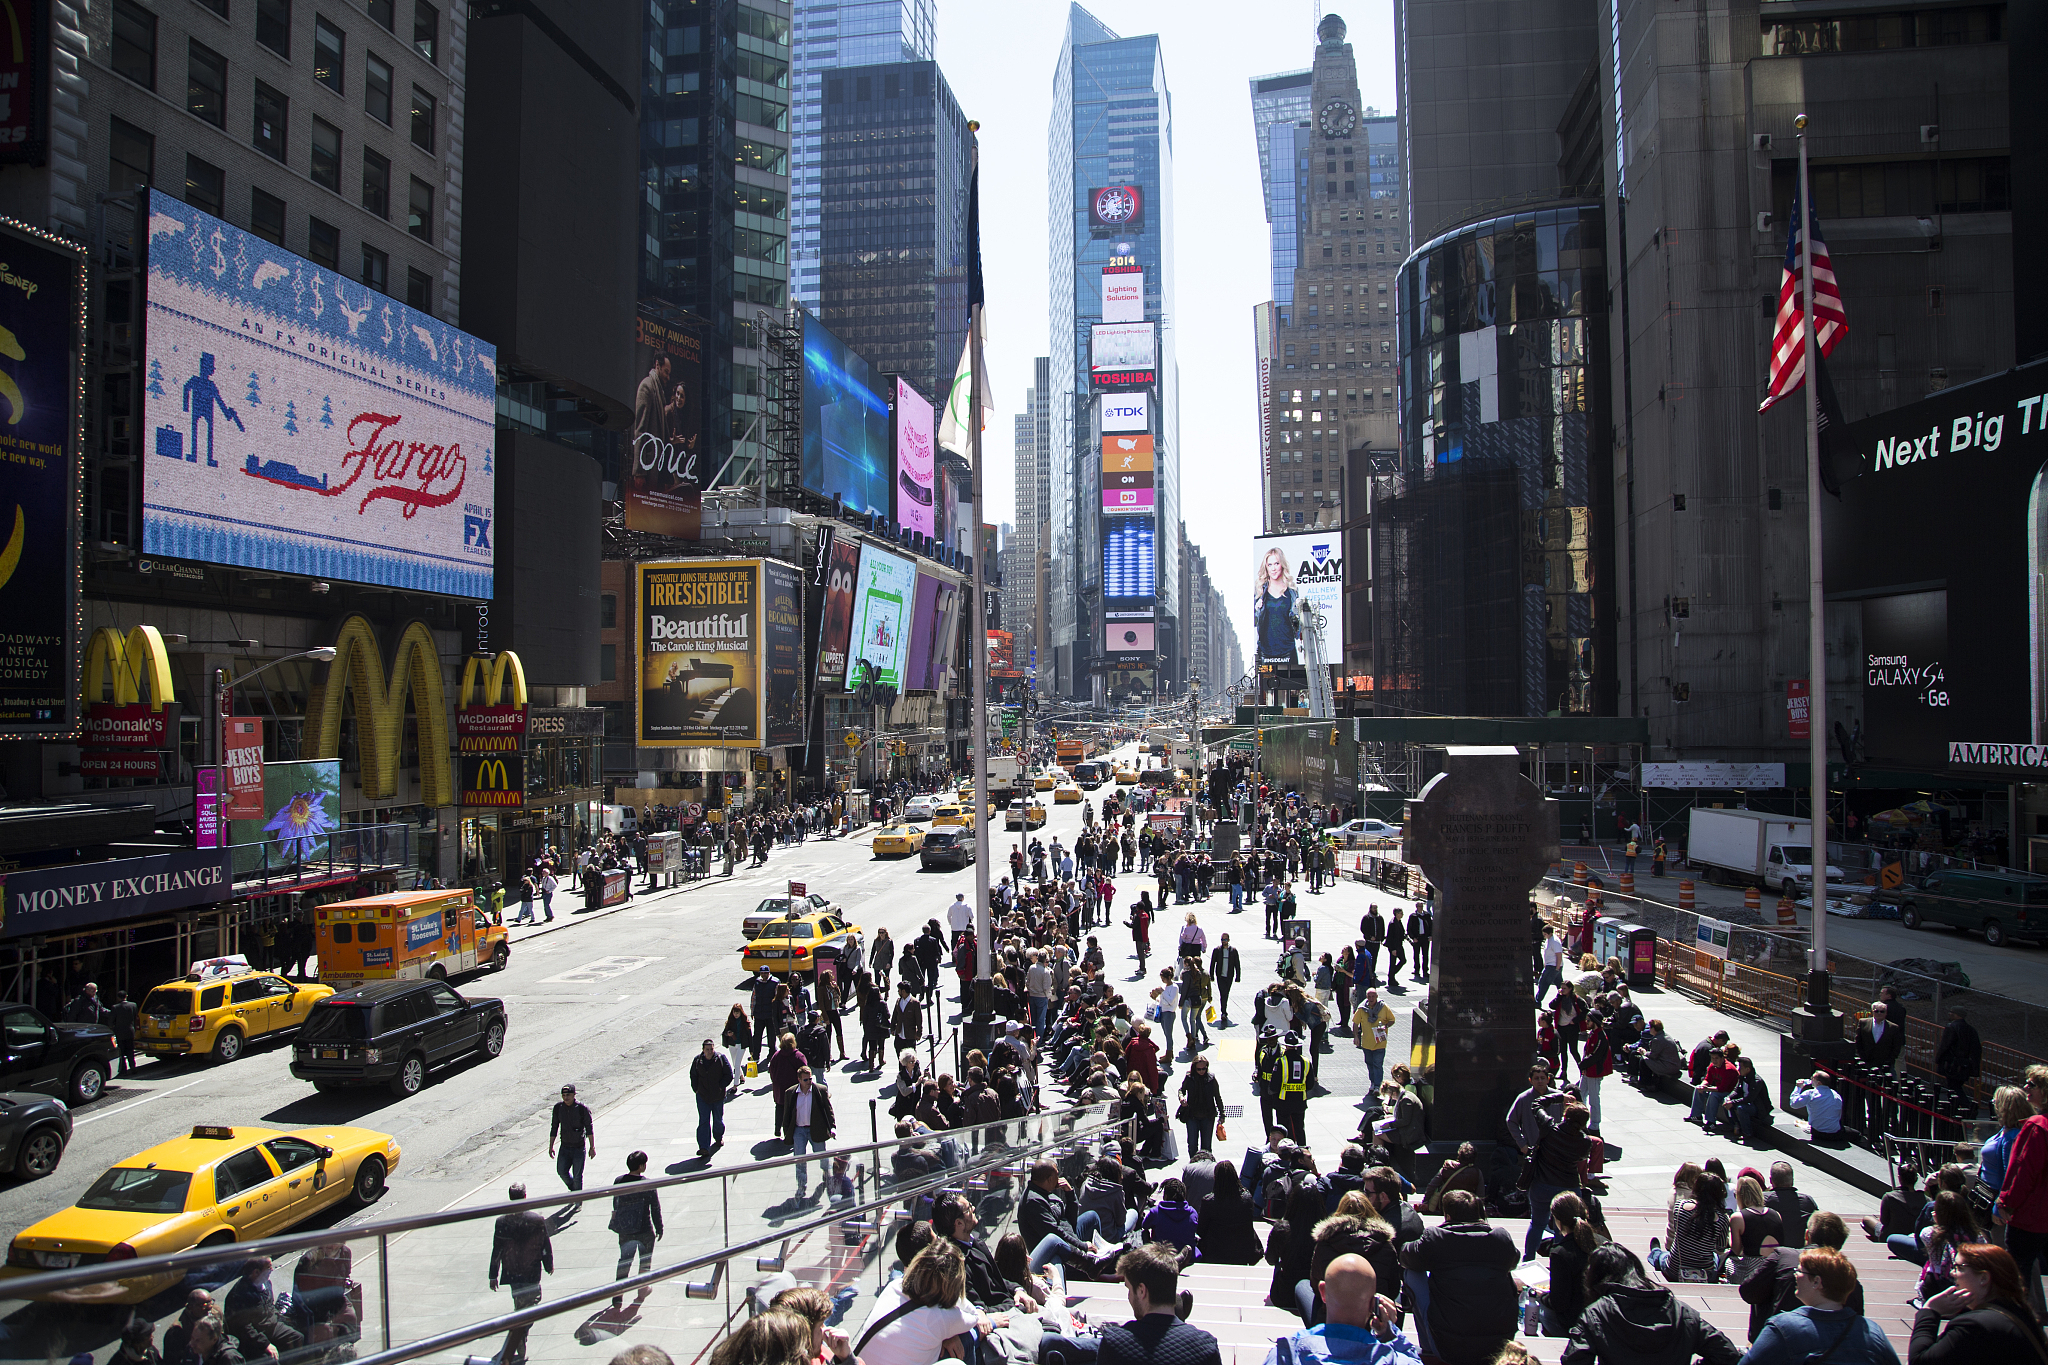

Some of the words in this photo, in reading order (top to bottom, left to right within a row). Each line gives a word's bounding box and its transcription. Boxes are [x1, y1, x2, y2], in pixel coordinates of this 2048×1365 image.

[1109, 256, 1136, 266] 2014
[1103, 265, 1142, 274] TOSHIBA
[643, 320, 666, 337] TONY
[667, 329, 700, 350] AWARDS
[644, 335, 666, 349] BEST
[667, 343, 700, 364] MUSICAL
[241, 318, 264, 334] AN
[276, 330, 296, 346] FX
[308, 342, 387, 379] ORIGINAL
[396, 375, 446, 401] SERIES
[1092, 372, 1155, 385] TOSHIBA
[1261, 357, 1270, 394] PHOTOS
[1113, 407, 1143, 417] TDK
[19, 439, 37, 451] new
[38, 442, 62, 456] world
[1874, 426, 1941, 472] Next
[1950, 411, 2005, 453] Big
[9, 451, 26, 463] new
[29, 456, 47, 469] way.
[341, 411, 467, 521] Fargo
[464, 503, 483, 517] APRIL
[485, 508, 492, 518] 15
[464, 514, 492, 549] FX
[464, 546, 492, 557] FEARLESS
[1313, 549, 1329, 559] INSIDE
[1297, 558, 1343, 578] AMY
[679, 572, 697, 583] JOINS
[697, 572, 708, 582] THE
[708, 571, 728, 582] RANKS
[729, 571, 737, 581] OF
[737, 571, 748, 581] THE
[1296, 574, 1342, 585] SCHUMER
[775, 595, 793, 609] BULLETS
[768, 610, 799, 627] BROADWAY
[651, 613, 748, 639] Beautiful
[8, 646, 36, 655] NEW
[651, 641, 667, 651] The
[667, 641, 694, 651] Carole
[695, 640, 715, 653] King
[716, 640, 748, 651] Musical
[1868, 654, 1907, 668] Samsung
[1868, 667, 1921, 686] GALAXY
[4, 698, 30, 706] Broadway
[50, 698, 66, 706] Street
[1787, 695, 1809, 710] JERSEY
[458, 713, 523, 724] McDonald's
[1790, 707, 1808, 720] BOYS
[82, 718, 163, 732] McDonald's
[92, 734, 149, 742] Restaurant
[227, 746, 264, 768] JERSEY
[82, 761, 107, 769] OPEN
[110, 761, 121, 769] 24
[124, 761, 156, 770] HOURS
[233, 765, 262, 786] BOYS
[513, 817, 534, 827] EXPRESS
[1446, 814, 1488, 822] LIEUTENANT
[1490, 814, 1525, 822] COLONEL
[1440, 824, 1482, 833] FRANCIS
[1496, 823, 1532, 833] DUFFY
[16, 882, 107, 915] MONEY
[111, 865, 223, 900] EXCHANGE
[411, 924, 419, 933] St.
[419, 921, 438, 931] Luke's
[411, 928, 439, 941] Roosevelt
